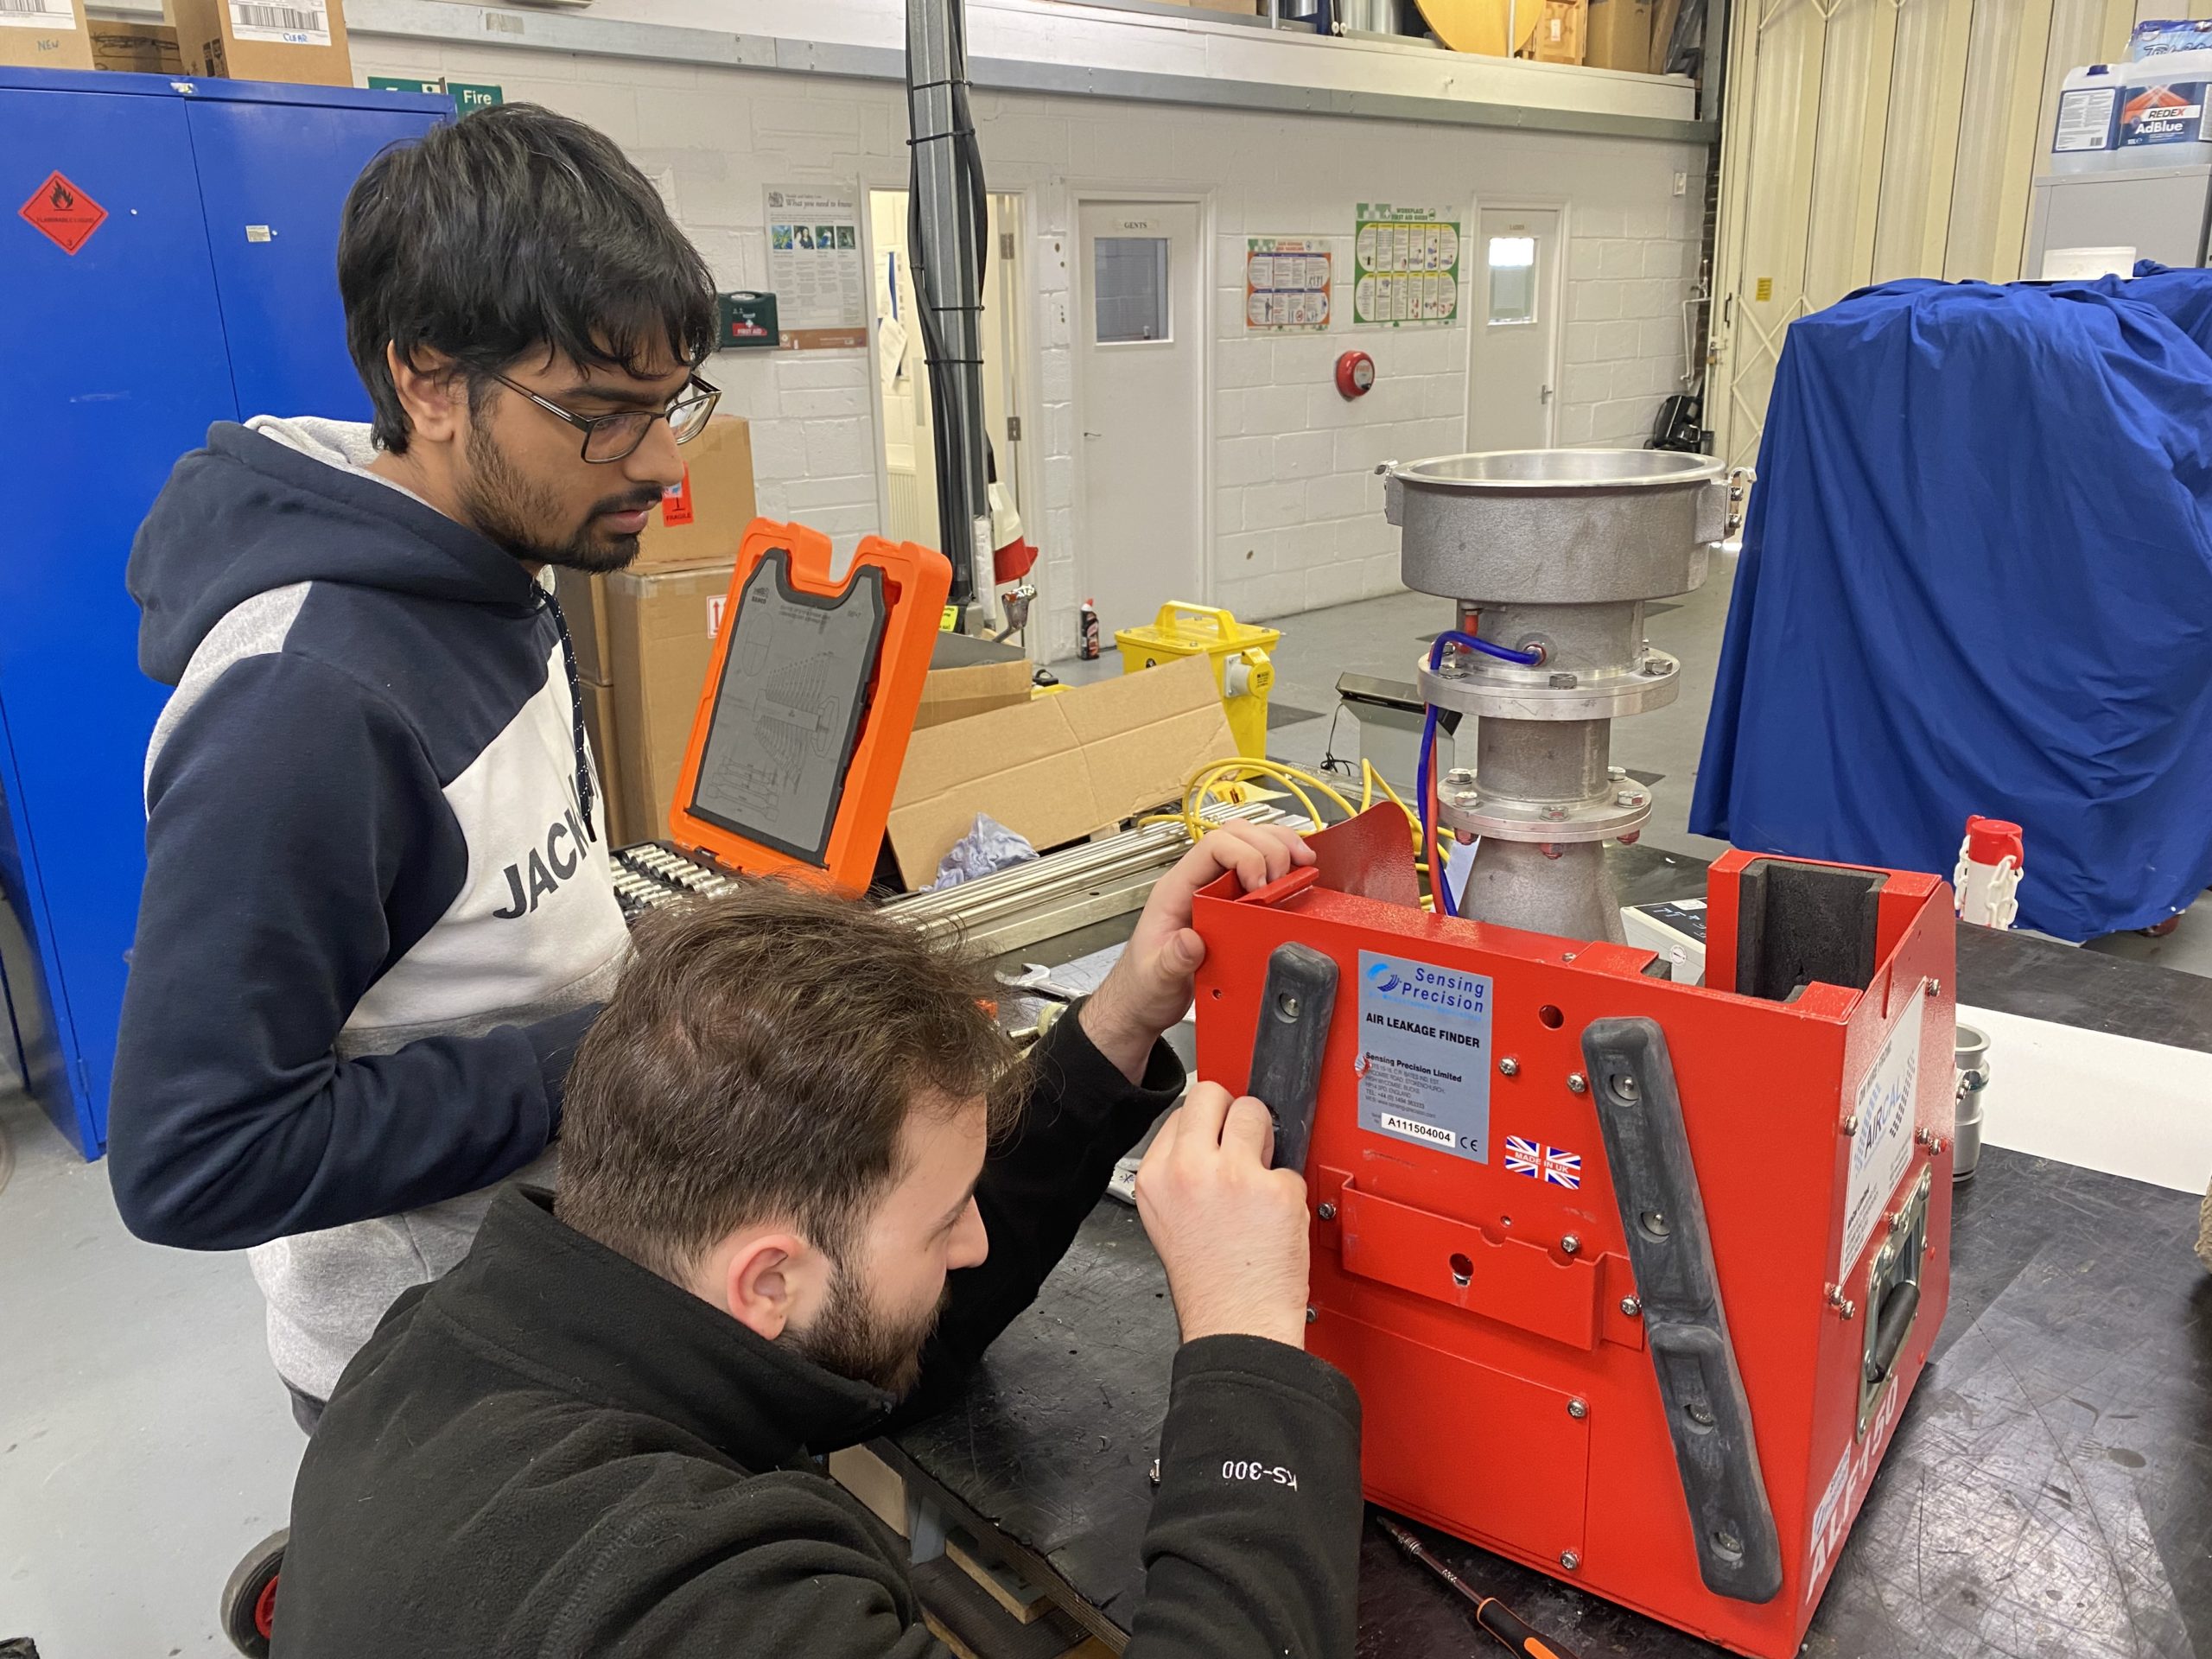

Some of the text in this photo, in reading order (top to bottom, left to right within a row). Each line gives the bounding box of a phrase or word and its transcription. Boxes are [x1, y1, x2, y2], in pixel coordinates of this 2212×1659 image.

[37, 40, 60, 52] NEW
[283, 32, 308, 42] CLEAR
[463, 90, 492, 105] Fire
[2148, 109, 2185, 118] REDEX
[2135, 121, 2183, 134] AdBlue
[785, 199, 803, 207] What
[837, 200, 853, 208] know
[1414, 967, 1484, 999] Sensing
[1402, 982, 1484, 1014] Precision
[1366, 1012, 1480, 1049] AIR LEAKAGE FINDER
[1365, 1052, 1462, 1083] Sensing Precision Limited
[1865, 1074, 1902, 1160] AIRCAL
[1388, 1117, 1451, 1141] A111504004
[1515, 1152, 1569, 1174] MADE IN UK
[1222, 1460, 1298, 1492] KS-300
